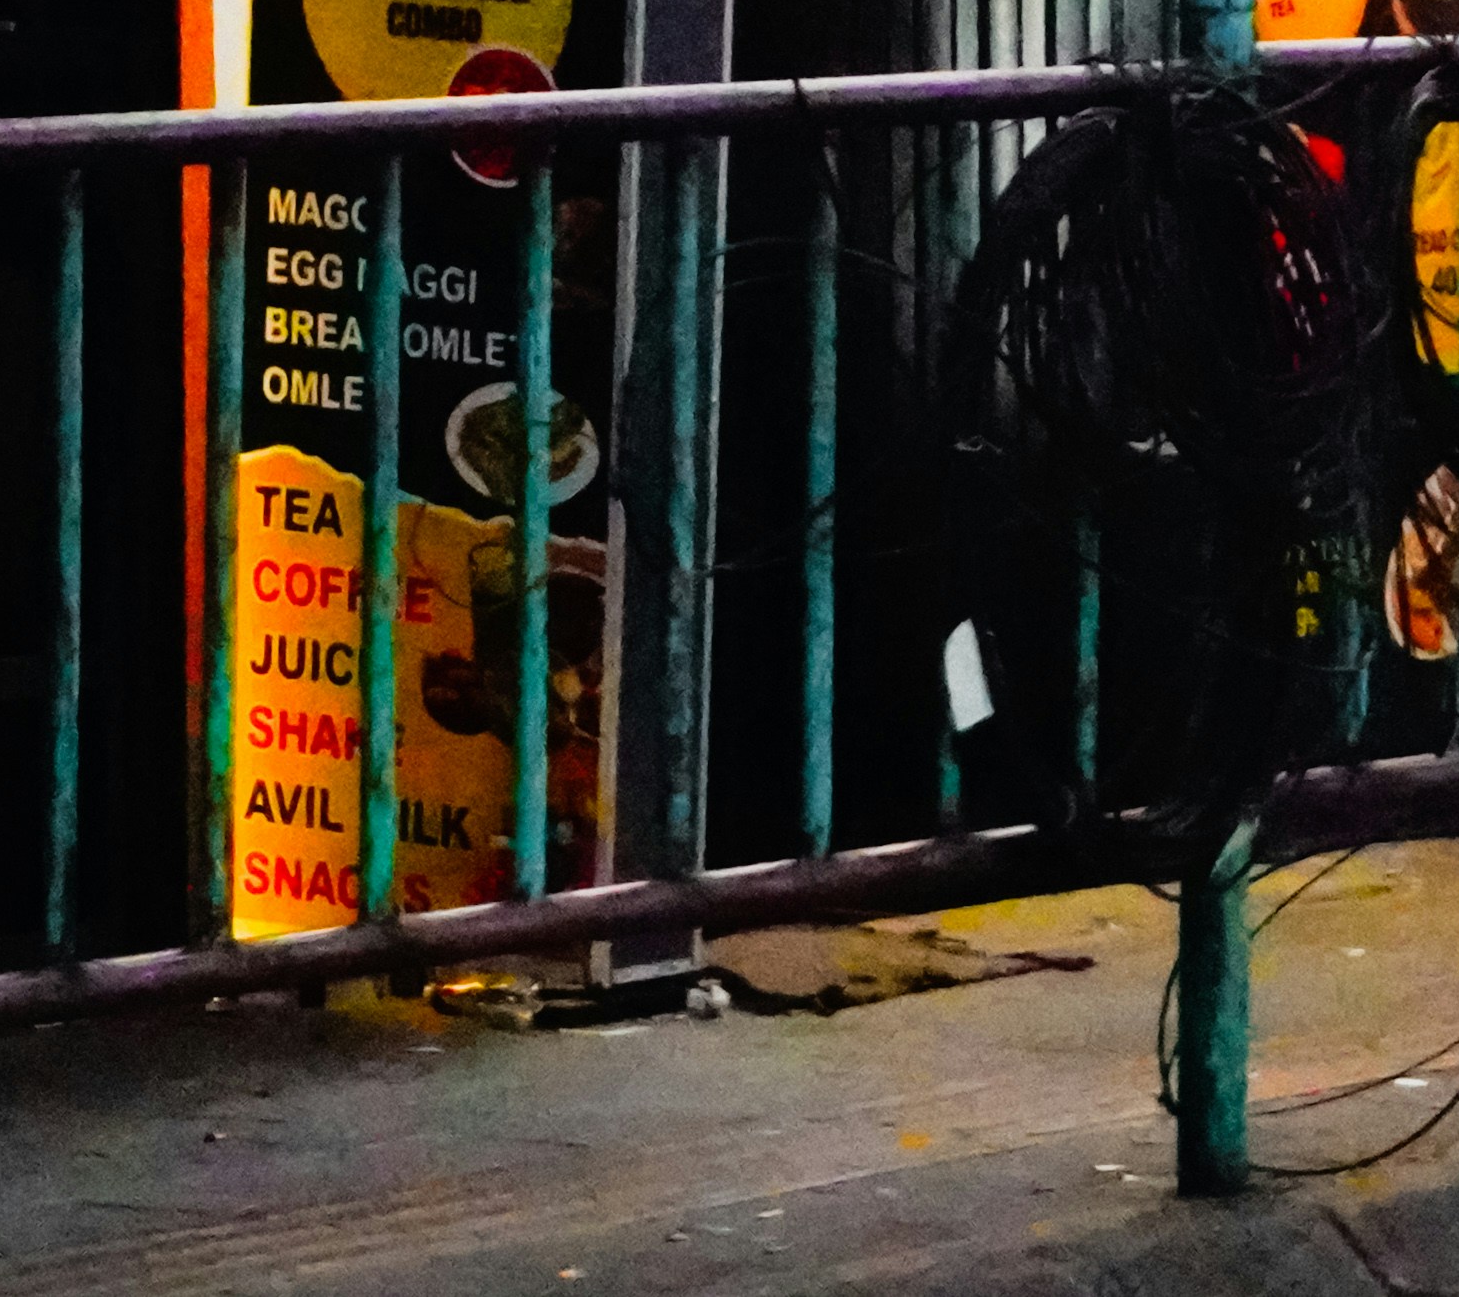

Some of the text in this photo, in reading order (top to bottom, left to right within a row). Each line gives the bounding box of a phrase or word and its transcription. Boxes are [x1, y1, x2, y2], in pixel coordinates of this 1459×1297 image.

[385, 1, 483, 43] COMBO
[267, 185, 368, 233] MAG
[265, 246, 344, 290] EGG
[264, 305, 518, 368] BREA OMLE
[262, 365, 365, 411] OMLE
[254, 484, 344, 539] TEA
[252, 557, 435, 625] COFE
[249, 633, 355, 688] JUIC
[247, 704, 404, 768] SHA
[243, 778, 474, 852] AVIL ILK
[243, 850, 433, 915] SNACS
